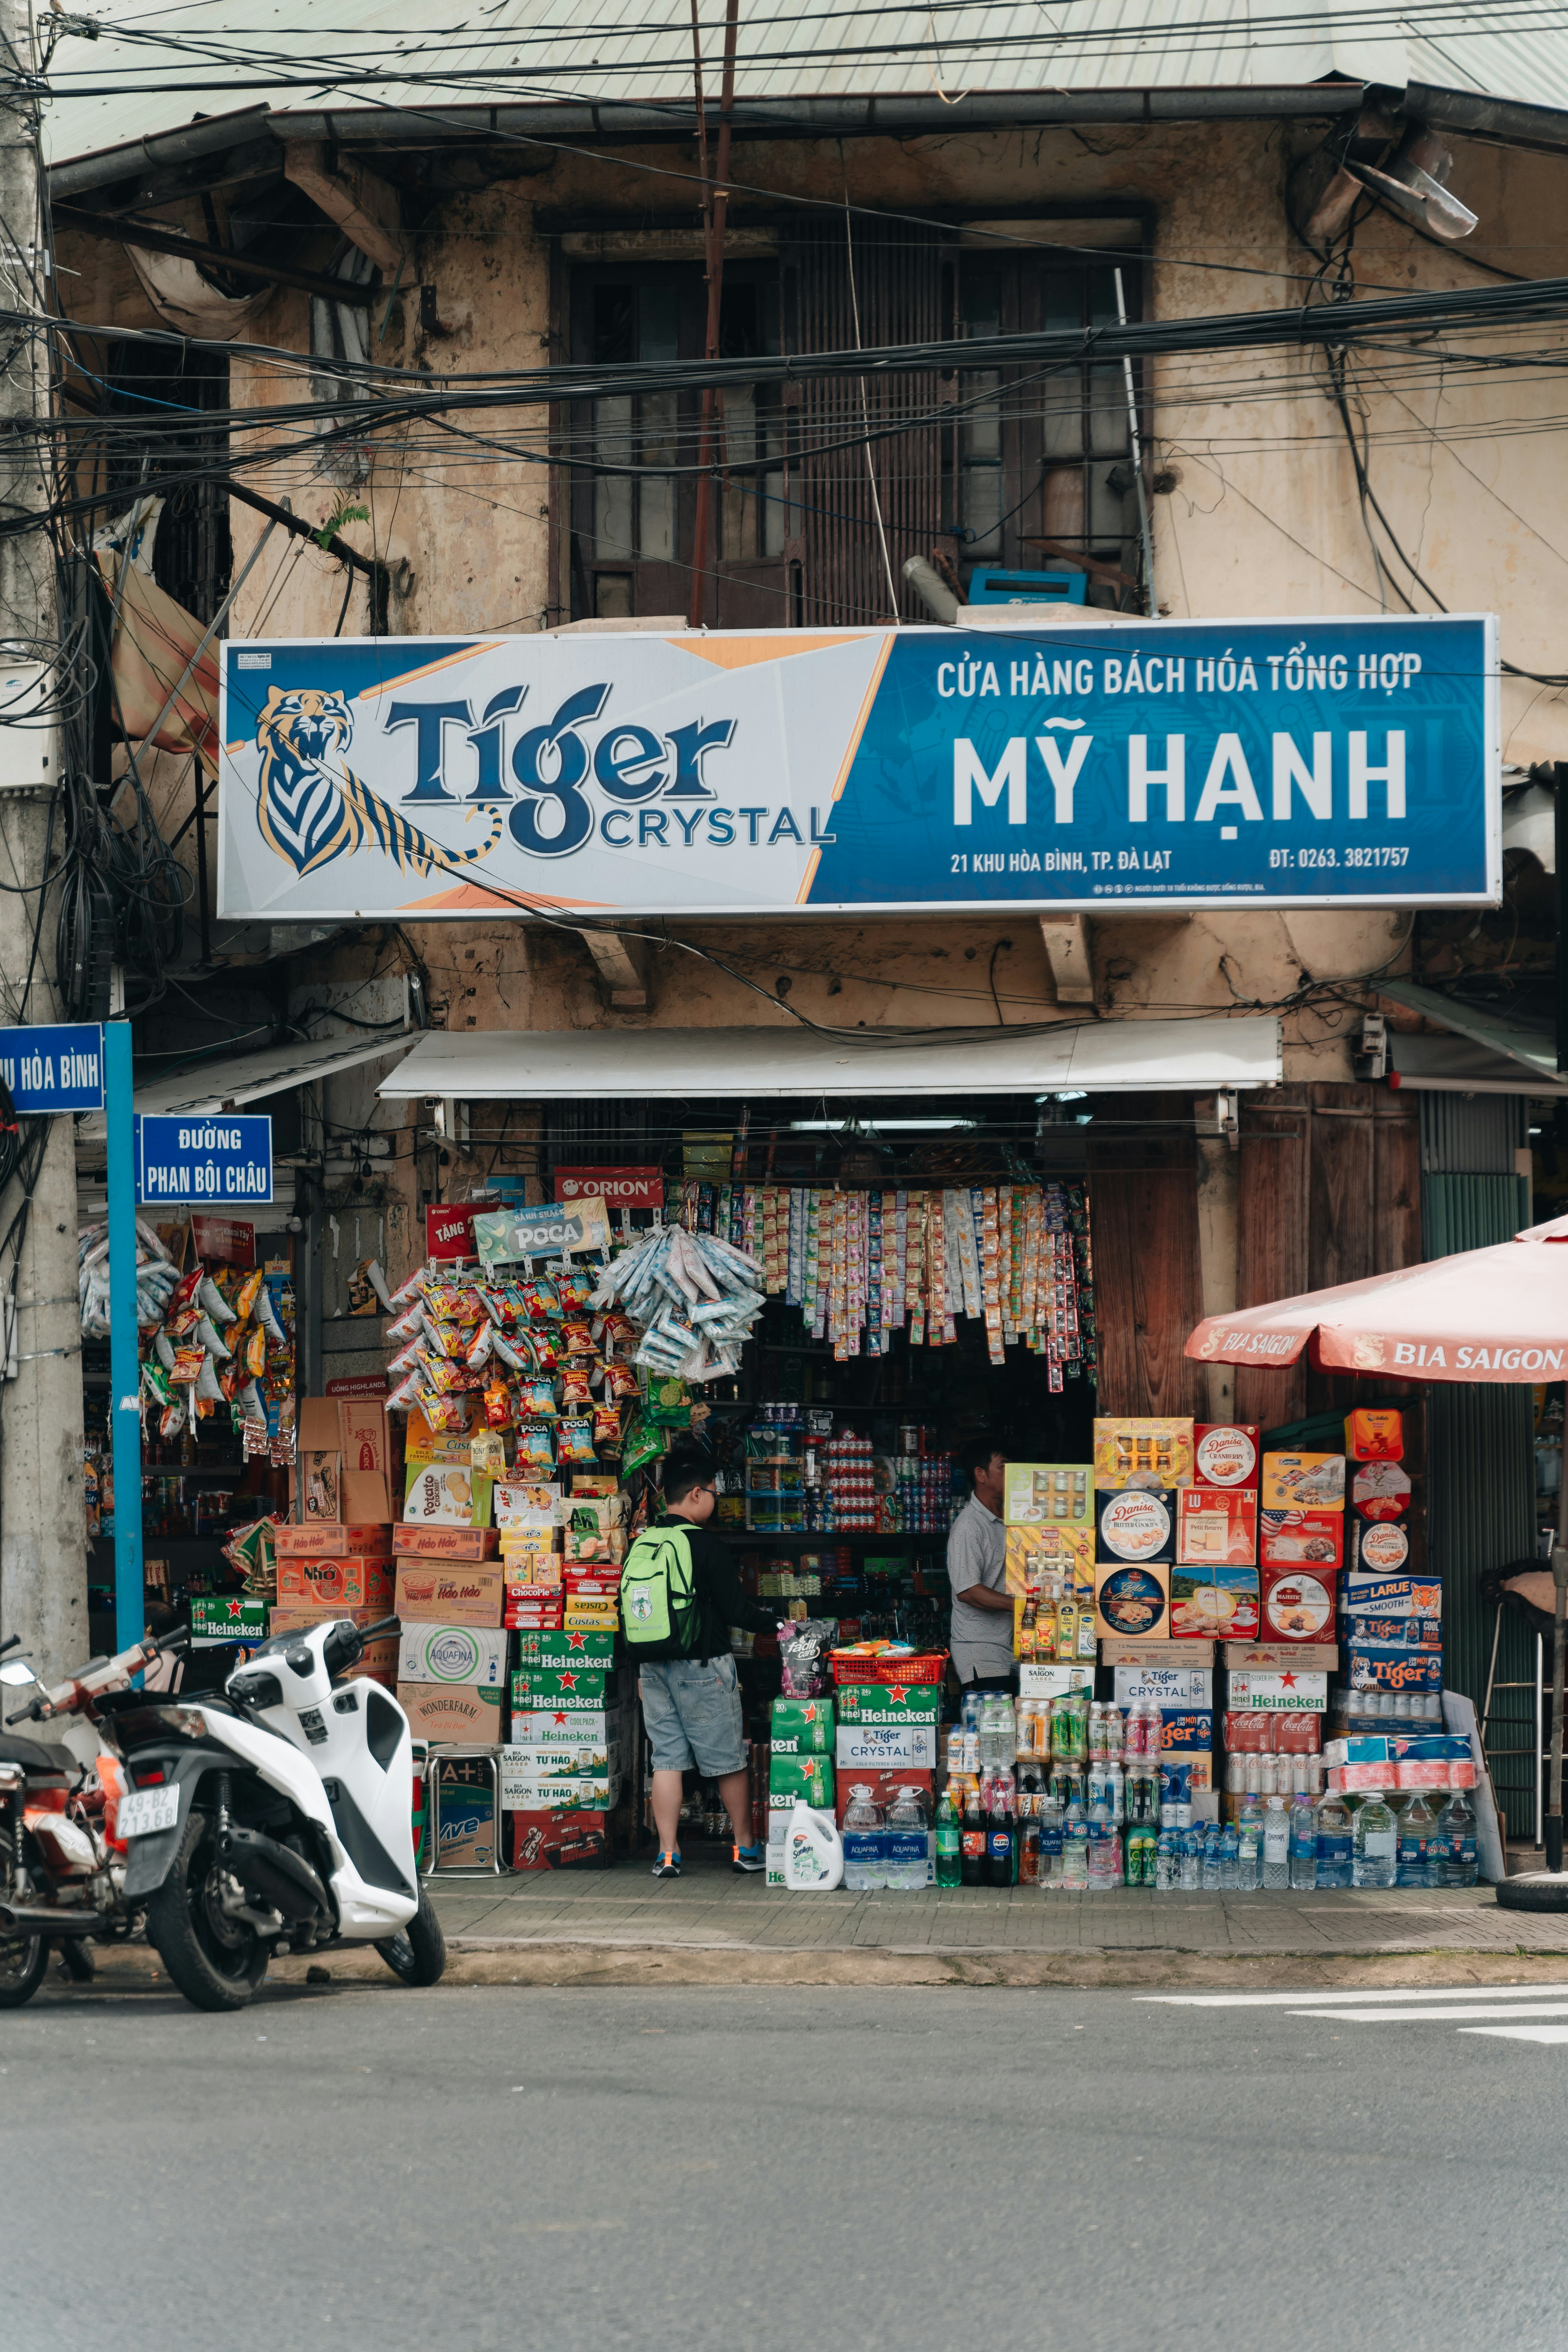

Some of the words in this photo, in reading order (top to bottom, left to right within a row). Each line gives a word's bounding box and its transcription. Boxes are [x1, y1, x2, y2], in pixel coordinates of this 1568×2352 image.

[938, 651, 1001, 698] CỬA
[1010, 652, 1093, 696] HÀNG
[1104, 650, 1185, 694] BÁCH
[1196, 648, 1258, 692] HÓA
[1267, 641, 1347, 690] TỔNG
[1358, 653, 1422, 697] HỢP
[381, 681, 737, 857] Tiger
[953, 717, 1093, 825] MỸ
[1129, 730, 1406, 840] HẠNH
[600, 807, 837, 846] CRYSTAL
[951, 854, 967, 872] 21
[974, 853, 1005, 872] KHU
[1010, 849, 1041, 871] HÒA
[1045, 848, 1087, 873] BÌNH,
[1092, 852, 1114, 870] TP.
[1118, 847, 1140, 869] ĐÀ
[1144, 851, 1172, 873] LẠT
[1270, 849, 1294, 867] ĐT:
[1299, 849, 1340, 867] 0263.
[1345, 847, 1409, 866] 3821757
[1175, 883, 1186, 891] TUỔI
[0, 1058, 15, 1091] U
[22, 1048, 55, 1090] HÒA
[60, 1047, 98, 1088] BÌNH
[179, 1121, 241, 1149] ĐƯỜNG
[148, 1166, 189, 1192] PHAN
[196, 1160, 220, 1197] BỘI
[226, 1161, 266, 1193] CHÂU
[584, 1181, 648, 1195] ORION
[514, 1211, 537, 1222] BÁNH
[540, 1208, 565, 1219] SNACK
[224, 1227, 239, 1236] Khoai
[240, 1229, 249, 1241] Tây
[435, 1221, 465, 1242] TẶNG
[515, 1223, 580, 1249] POCA
[1221, 1332, 1251, 1351] BIA
[1247, 1333, 1299, 1354] SAIGON
[1393, 1343, 1446, 1367] BIA
[1456, 1347, 1561, 1370] SAIGON
[332, 1383, 349, 1392] UỐNG
[350, 1382, 385, 1390] HIGHLANDS
[1206, 1437, 1243, 1452] Danisa
[424, 1474, 436, 1516] Potato
[1189, 1494, 1201, 1508] LU
[1112, 1502, 1156, 1521] Danisa
[417, 1537, 436, 1549] Hảo
[438, 1536, 457, 1548] Hảo
[304, 1566, 336, 1580] Nhớ
[438, 1586, 458, 1600] Hảo
[460, 1584, 481, 1598] Hảo
[512, 1588, 550, 1597] ChocoPie
[1112, 1582, 1146, 1599] Gold
[1370, 1581, 1410, 1598] LARUE
[574, 1602, 608, 1612] Custas
[1370, 1599, 1404, 1613] SMOOTH
[568, 1617, 601, 1626] Custas
[1423, 1621, 1439, 1631] COOL
[1423, 1631, 1439, 1642] PACK
[788, 1639, 817, 1653] fadil
[798, 1648, 815, 1658] care
[1151, 1671, 1178, 1684] Tiger
[1129, 1687, 1187, 1697] CRYSTAL
[1252, 1694, 1325, 1708] Heineken
[419, 1700, 477, 1719] WONDERFARM
[861, 1709, 936, 1722] Heineken
[570, 1717, 595, 1726] COOLPACK
[851, 1746, 911, 1757] CRYSTAL
[536, 1756, 549, 1766] TỰ
[552, 1754, 570, 1764] HÀO
[442, 1762, 476, 1781] A+
[538, 1789, 550, 1799] TỰ
[553, 1787, 572, 1797] HÀO
[127, 1788, 170, 1813] 49-B2
[120, 1808, 174, 1836] 213.68
[793, 1846, 813, 1859] Sunlight
